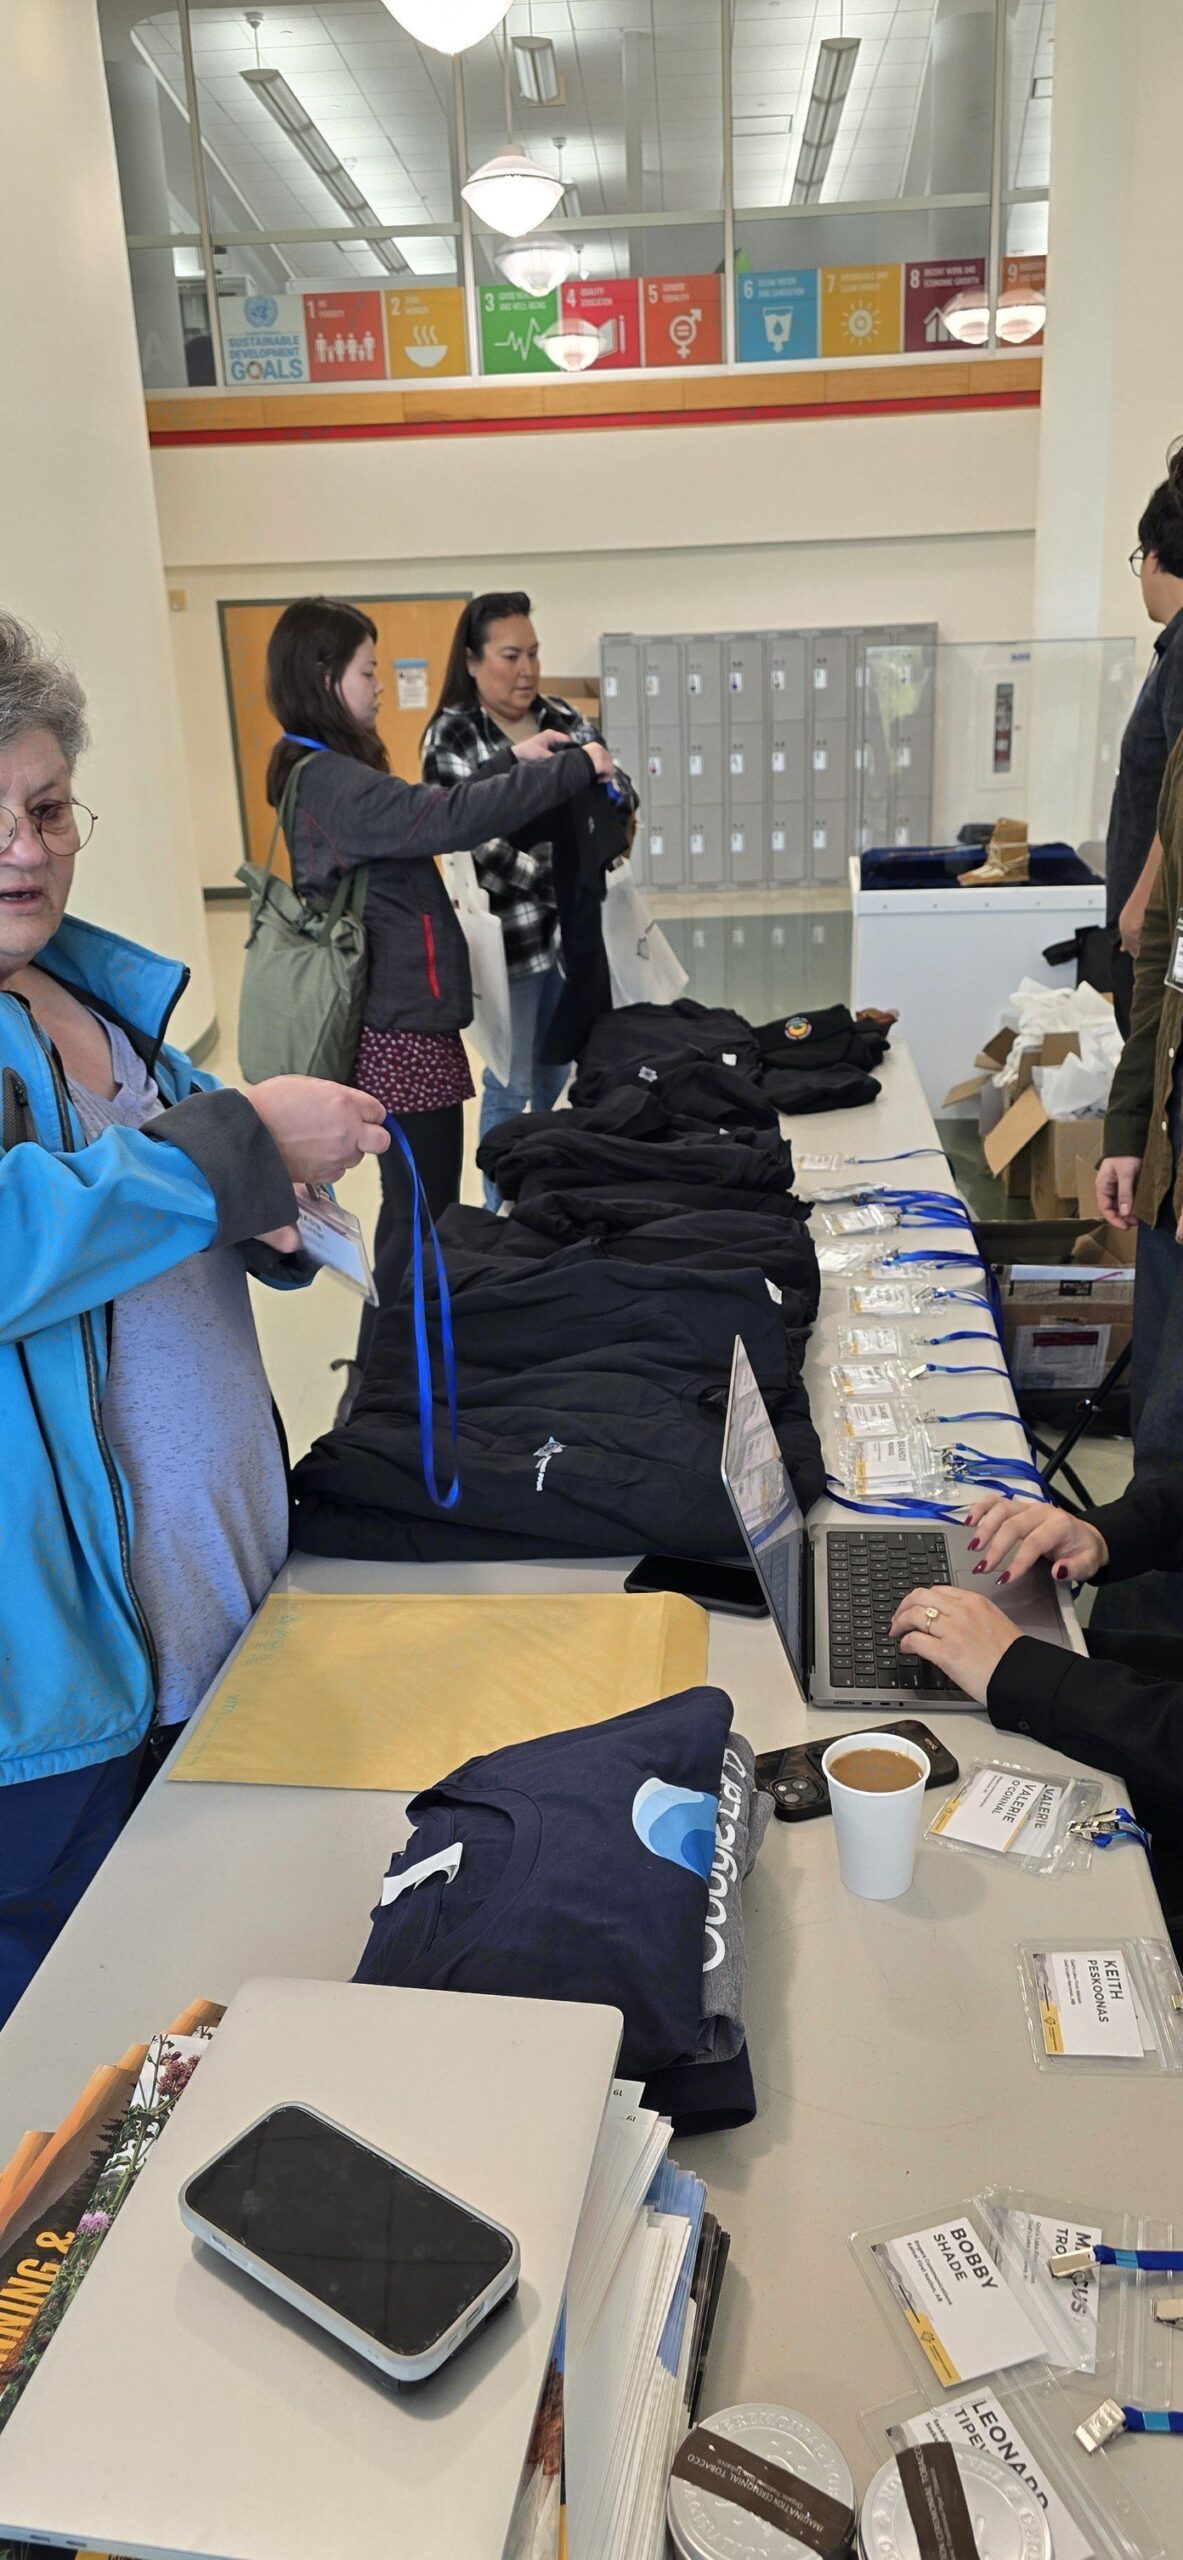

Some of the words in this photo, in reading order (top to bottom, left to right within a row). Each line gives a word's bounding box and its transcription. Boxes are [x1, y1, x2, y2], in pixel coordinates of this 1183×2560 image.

[827, 274, 836, 294] 7
[910, 268, 920, 289] 8
[1007, 263, 1018, 283] 9
[566, 288, 577, 308] 4
[648, 284, 658, 303] 5
[743, 280, 754, 299] 6
[306, 300, 316, 319] 1
[390, 296, 401, 316] 2
[484, 292, 495, 312] 3
[231, 358, 303, 381] GOALS
[1002, 1784, 1037, 1823] VALERIE
[1034, 1788, 1056, 1829] VALERIE
[1087, 1959, 1109, 2023] PESKOONAS
[1103, 1960, 1124, 2000] KEITH
[35, 2231, 76, 2254] &
[934, 2233, 968, 2281] SHADE
[949, 2227, 998, 2290] BOBBY
[954, 2408, 990, 2453] TIPE
[687, 2453, 726, 2478] TOBACCO
[728, 2472, 773, 2503] CEREMONIAL
[772, 2495, 824, 2533] IMAGINATION
